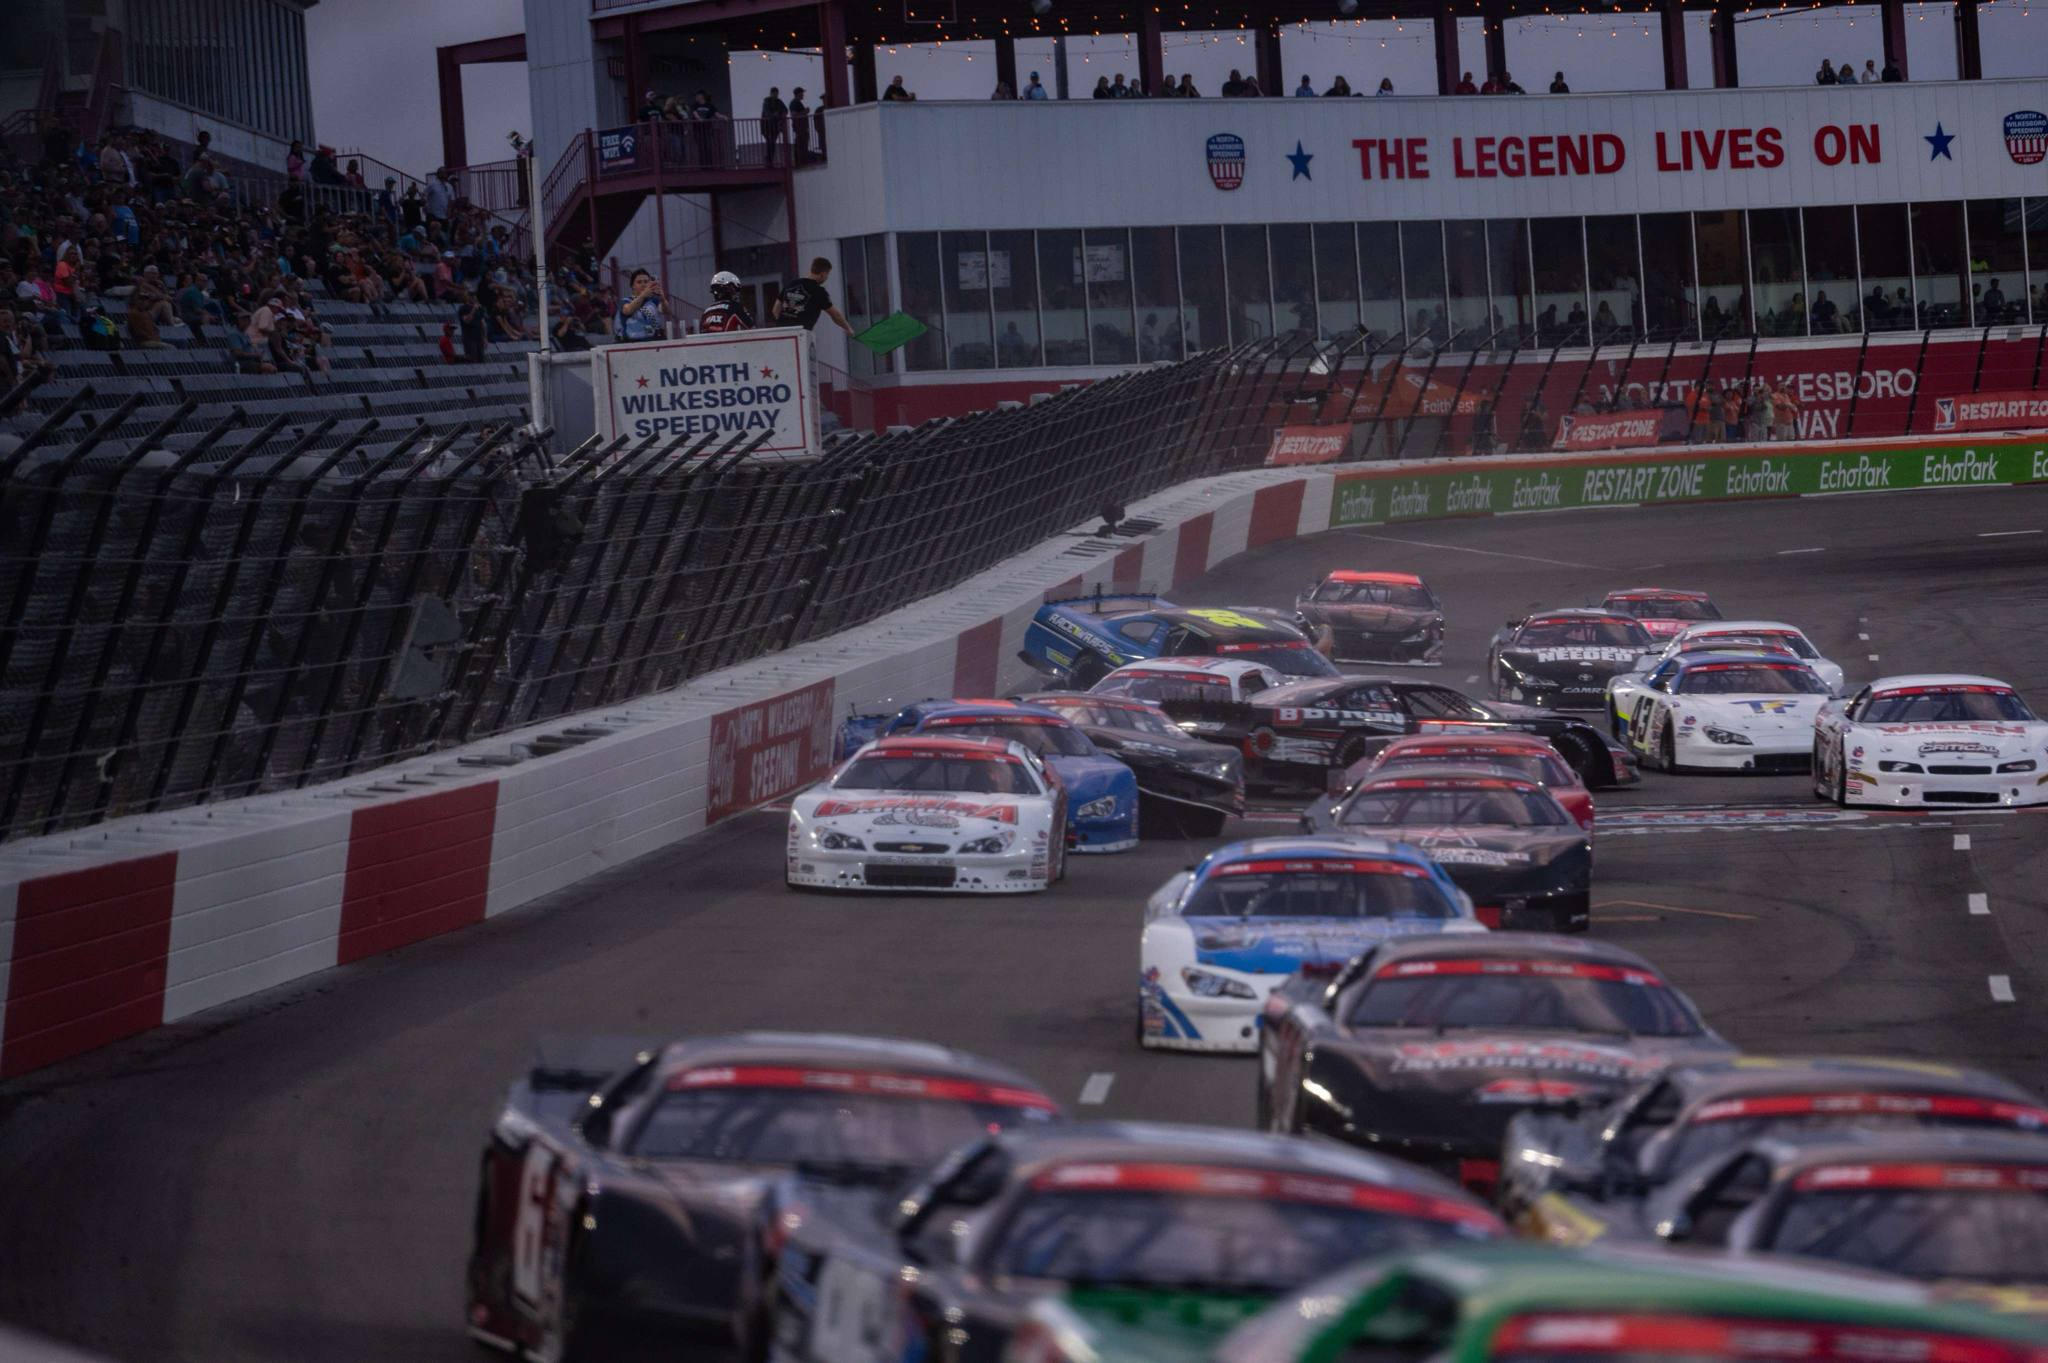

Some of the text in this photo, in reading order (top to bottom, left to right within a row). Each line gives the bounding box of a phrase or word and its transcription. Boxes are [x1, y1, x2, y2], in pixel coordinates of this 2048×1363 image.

[1352, 124, 1881, 180] THE LEGEND LIVES ON
[660, 362, 750, 388] NORTH
[622, 384, 791, 414] WILKESBORO
[1600, 379, 1698, 403] NORT
[1423, 399, 1476, 414] Faithest
[1960, 401, 2027, 420] RESTART
[635, 409, 780, 438] SPEEDWAY
[1621, 418, 1656, 437] ZONE
[1726, 459, 1791, 495] EchoPark
[1819, 455, 1891, 490] EchoPark
[1923, 450, 1998, 483] EchoPark
[1512, 472, 1562, 508] EchoPark
[1582, 463, 1706, 502] RESTART ZONE
[1877, 723, 2025, 735] WHELEN
[1920, 743, 1998, 754] CRITICAL
